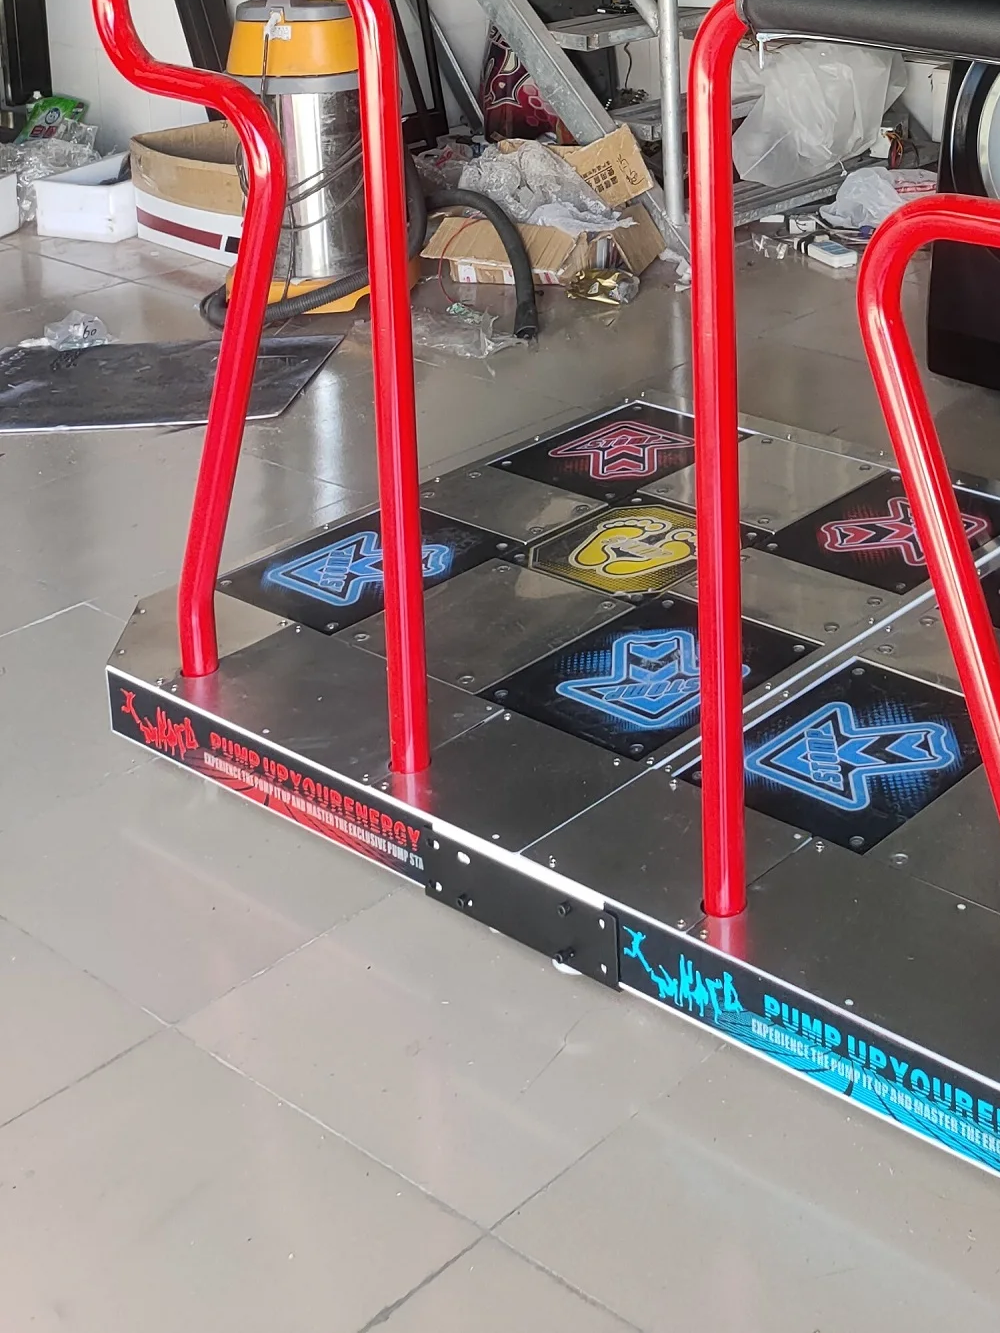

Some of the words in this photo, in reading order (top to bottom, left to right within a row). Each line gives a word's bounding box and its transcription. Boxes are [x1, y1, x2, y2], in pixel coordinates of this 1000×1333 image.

[210, 732, 261, 769] PUMP
[803, 727, 842, 785] STOMP
[204, 751, 242, 781] EXPERIENCE
[335, 815, 348, 834] THE
[349, 823, 387, 852] EXCLUSIVE
[387, 840, 409, 863] PUMP
[409, 852, 425, 871] STA
[764, 994, 842, 1051] PUMP
[751, 1018, 809, 1060] EXPERIENCE
[810, 1046, 831, 1069] THE
[830, 1058, 861, 1084] PUMP
[862, 1072, 873, 1091] IT
[874, 1077, 889, 1098] UP
[890, 1085, 913, 1110] AND
[914, 1097, 958, 1134] MASTER
[960, 1120, 983, 1146] THE
